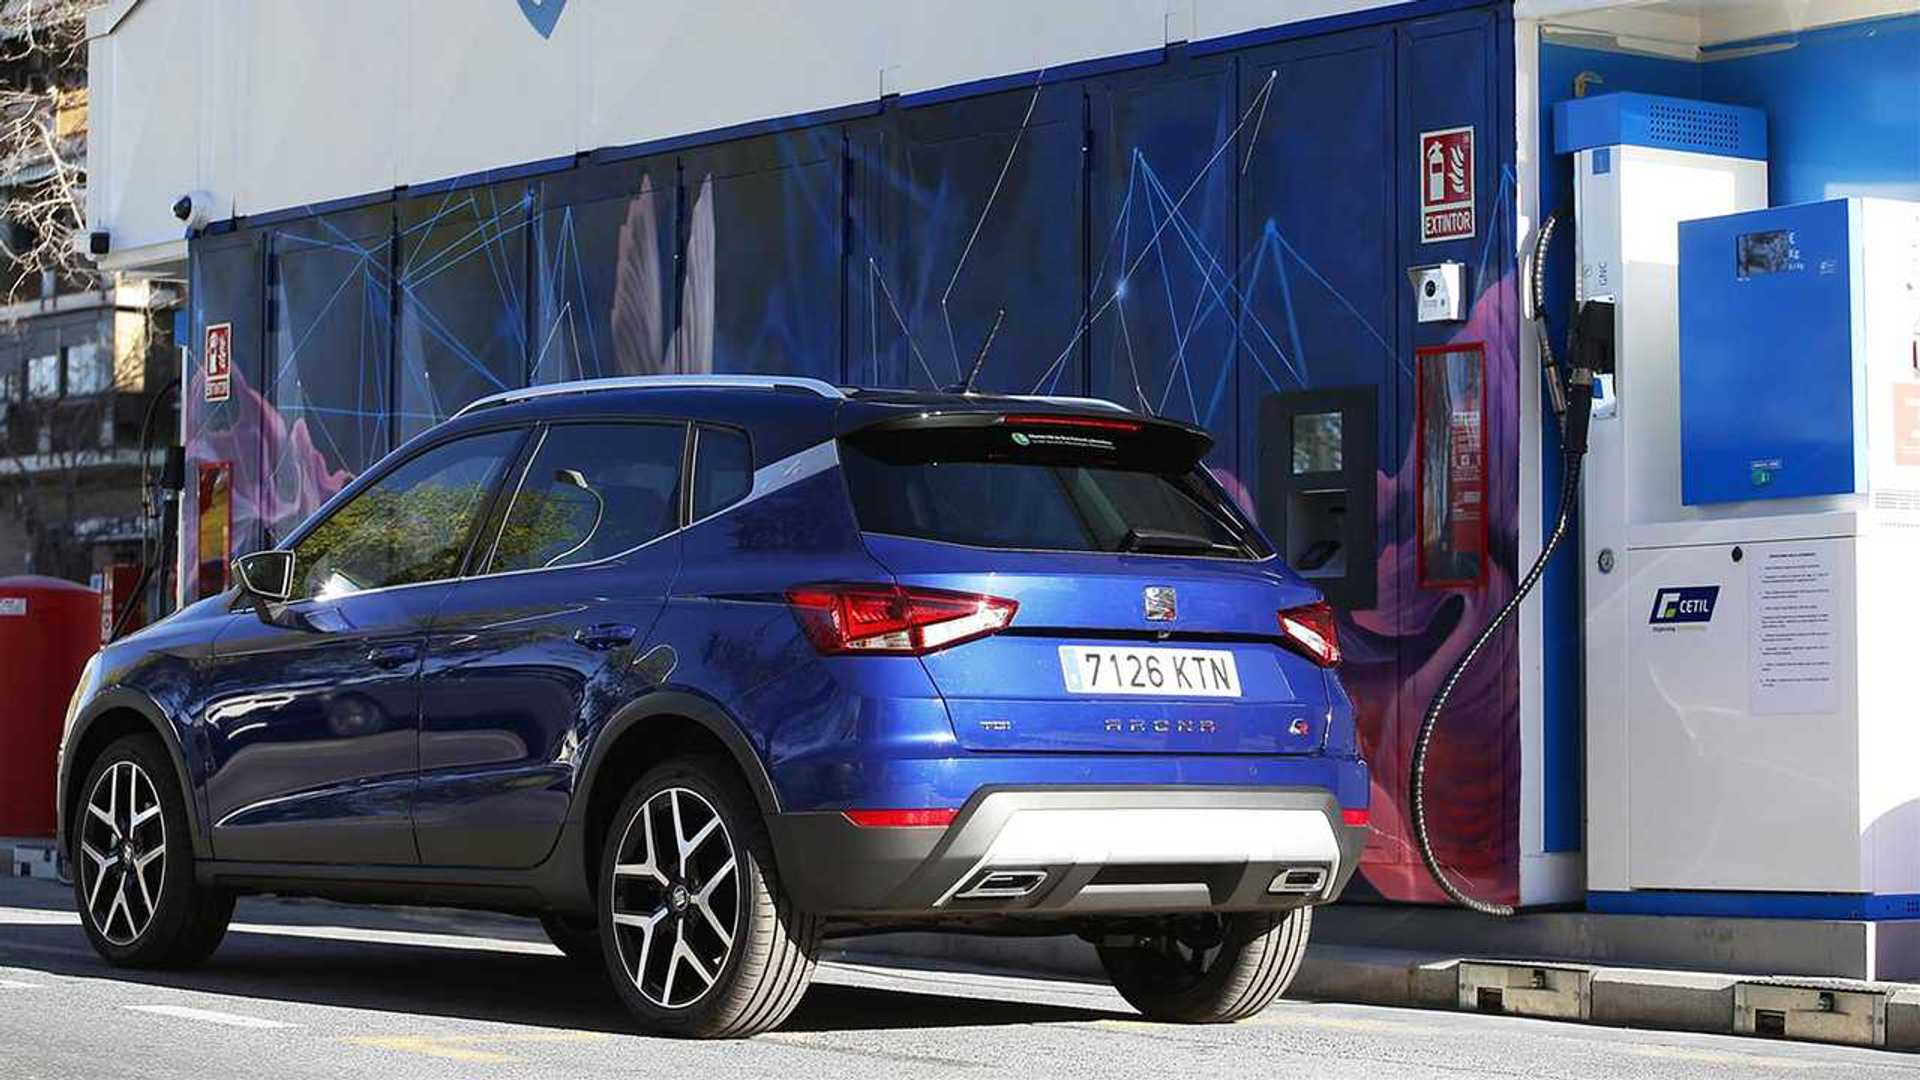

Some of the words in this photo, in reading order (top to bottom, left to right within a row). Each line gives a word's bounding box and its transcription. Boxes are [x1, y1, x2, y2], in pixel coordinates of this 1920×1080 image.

[1425, 212, 1471, 235] EXTINTOR
[1680, 599, 1709, 613] CETIL
[1085, 654, 1164, 687] 7126
[1173, 656, 1231, 690] KTN
